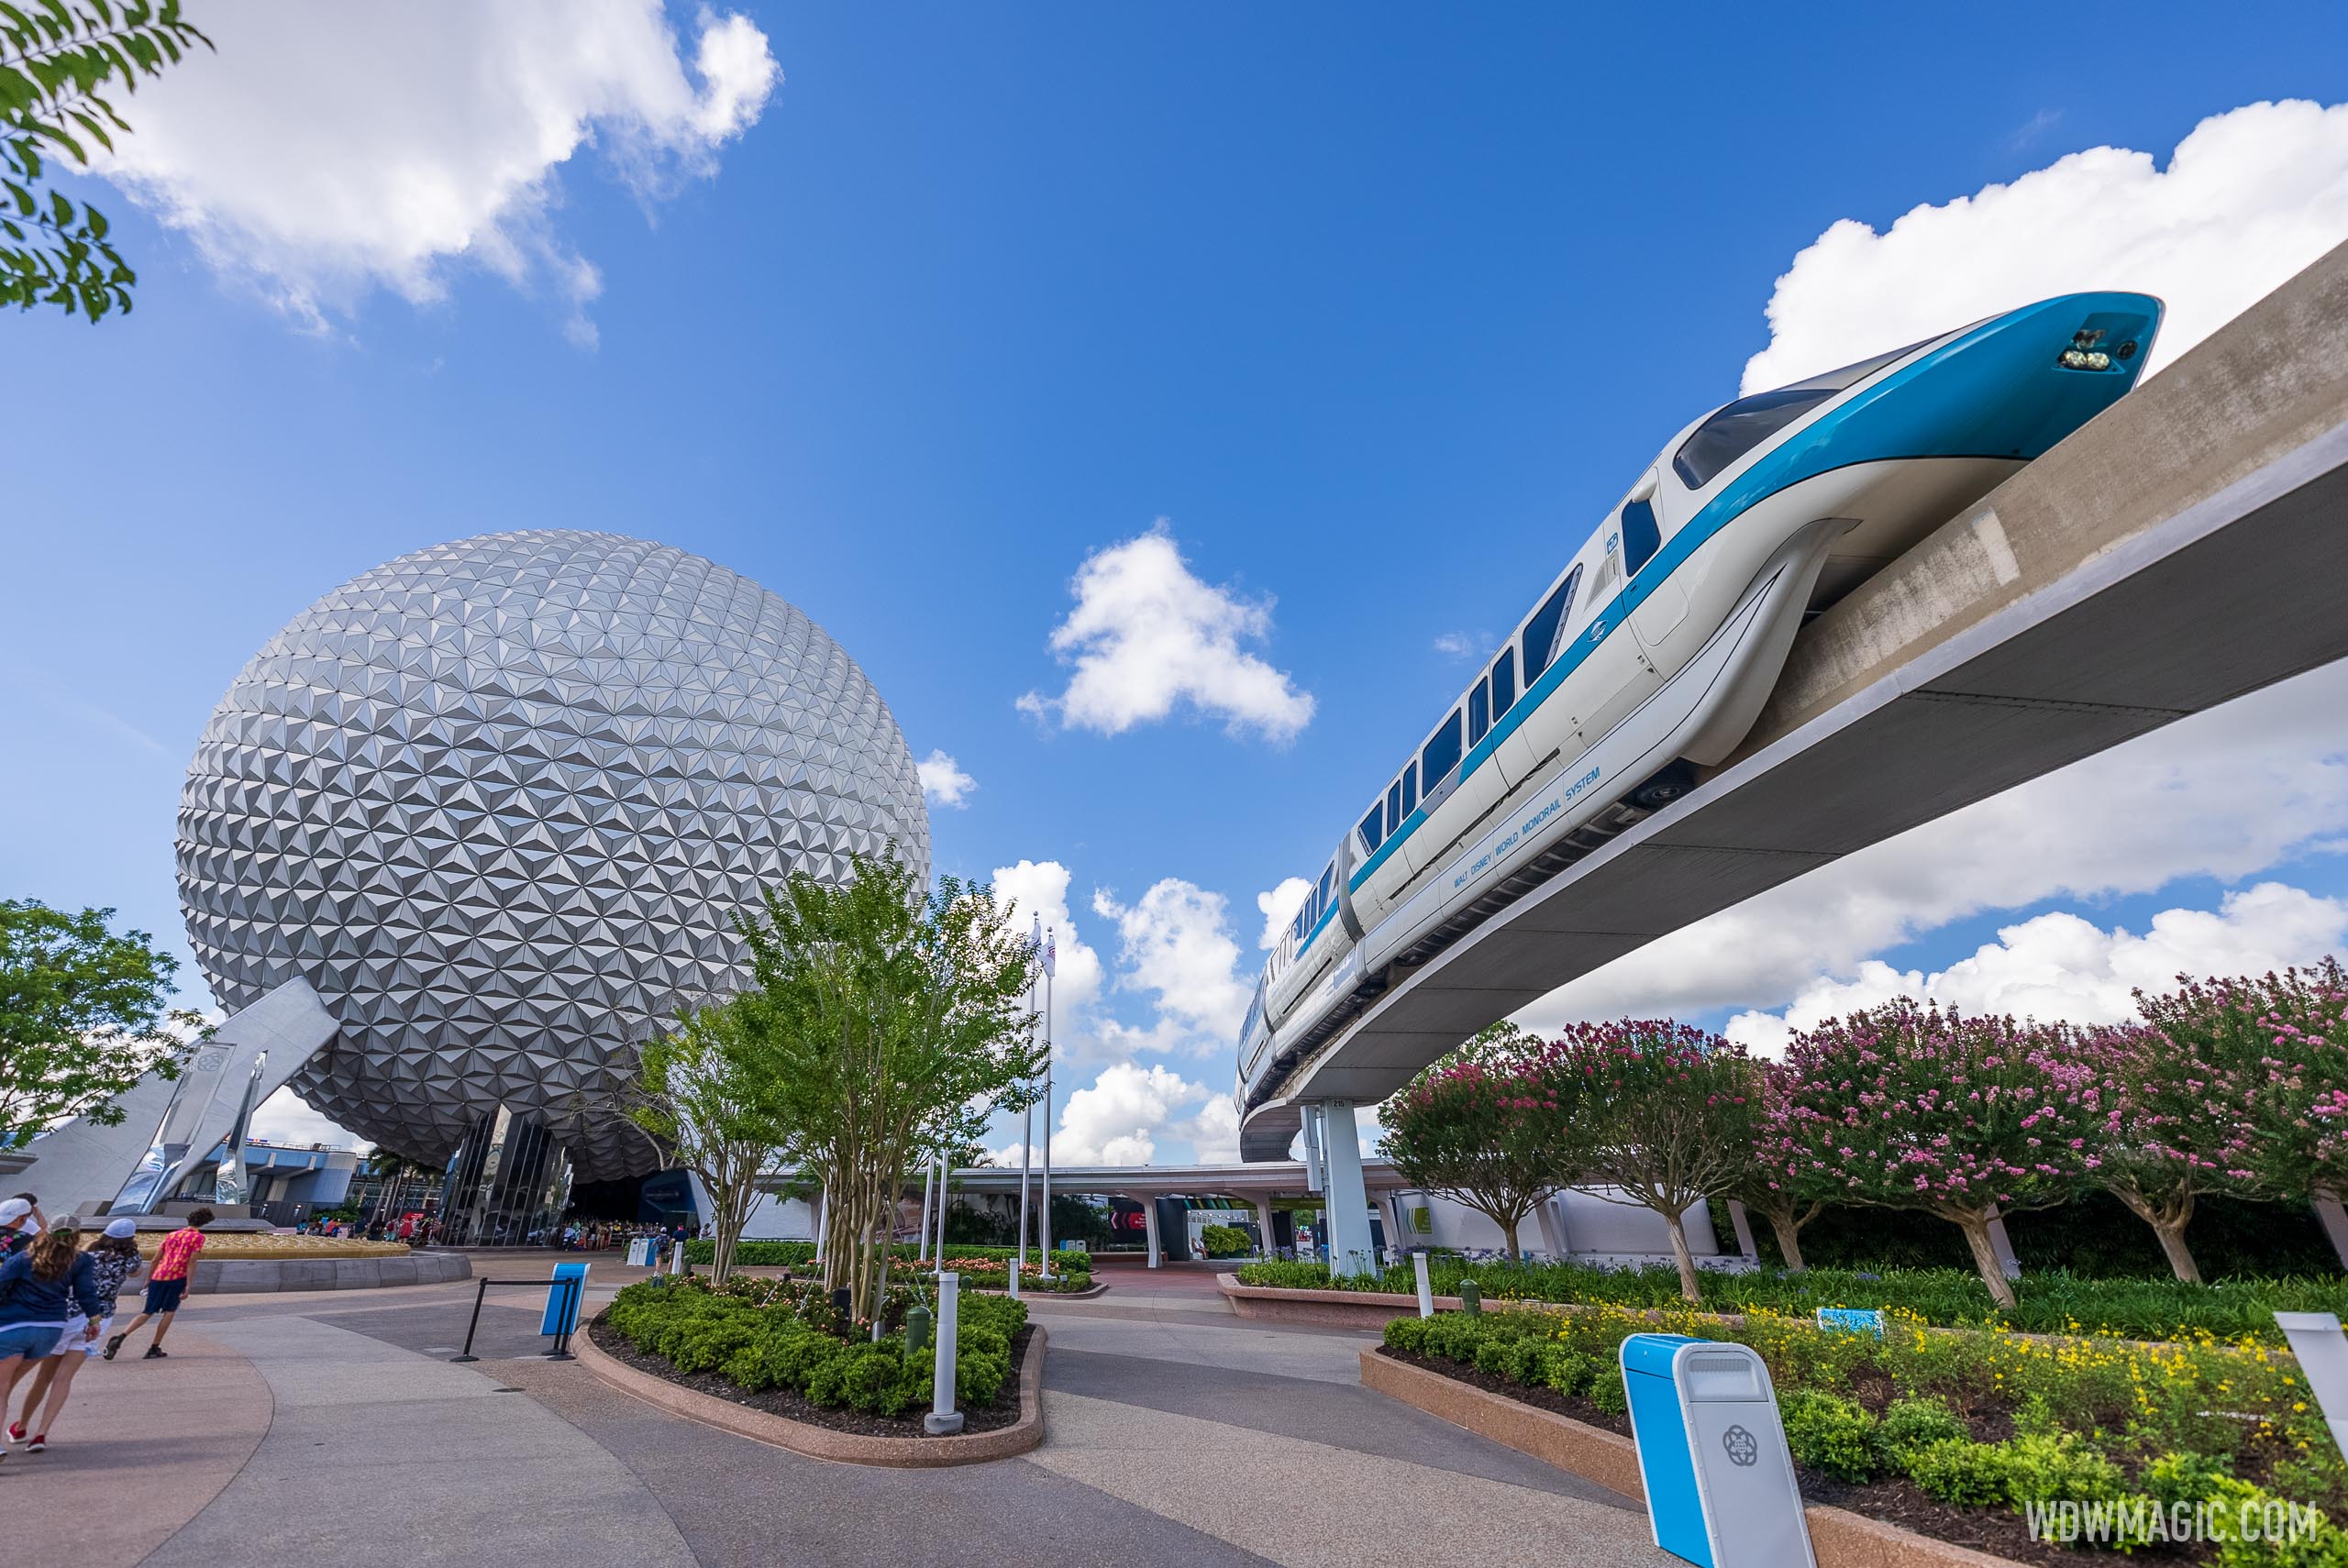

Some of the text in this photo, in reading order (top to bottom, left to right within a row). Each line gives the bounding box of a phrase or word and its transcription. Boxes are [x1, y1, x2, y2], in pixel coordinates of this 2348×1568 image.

[1454, 766, 1600, 889] WALT DISNEY WORLD MONORAIL SYSTEM
[1334, 1099, 1345, 1108] 215
